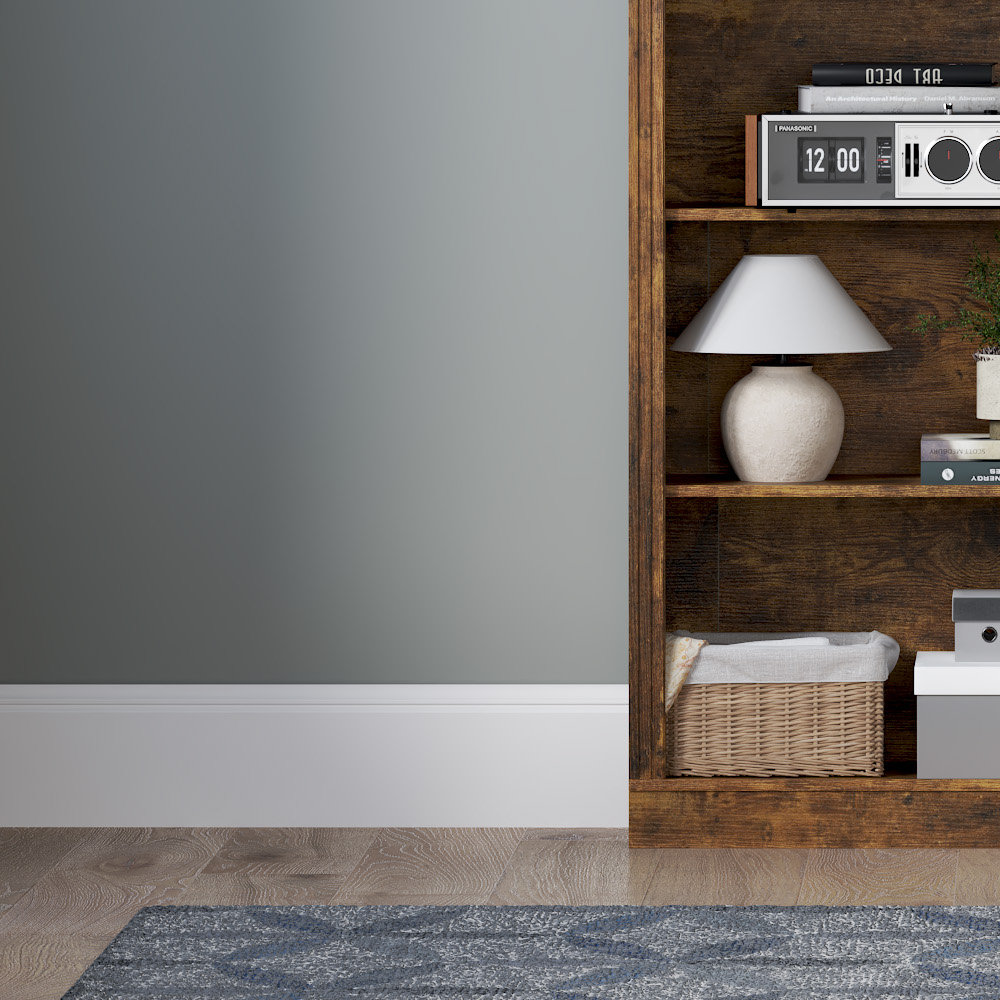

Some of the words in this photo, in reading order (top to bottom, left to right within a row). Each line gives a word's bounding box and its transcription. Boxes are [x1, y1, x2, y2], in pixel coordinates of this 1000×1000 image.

[889, 95, 917, 103] History
[806, 147, 825, 172] 12
[837, 147, 860, 172] 00
